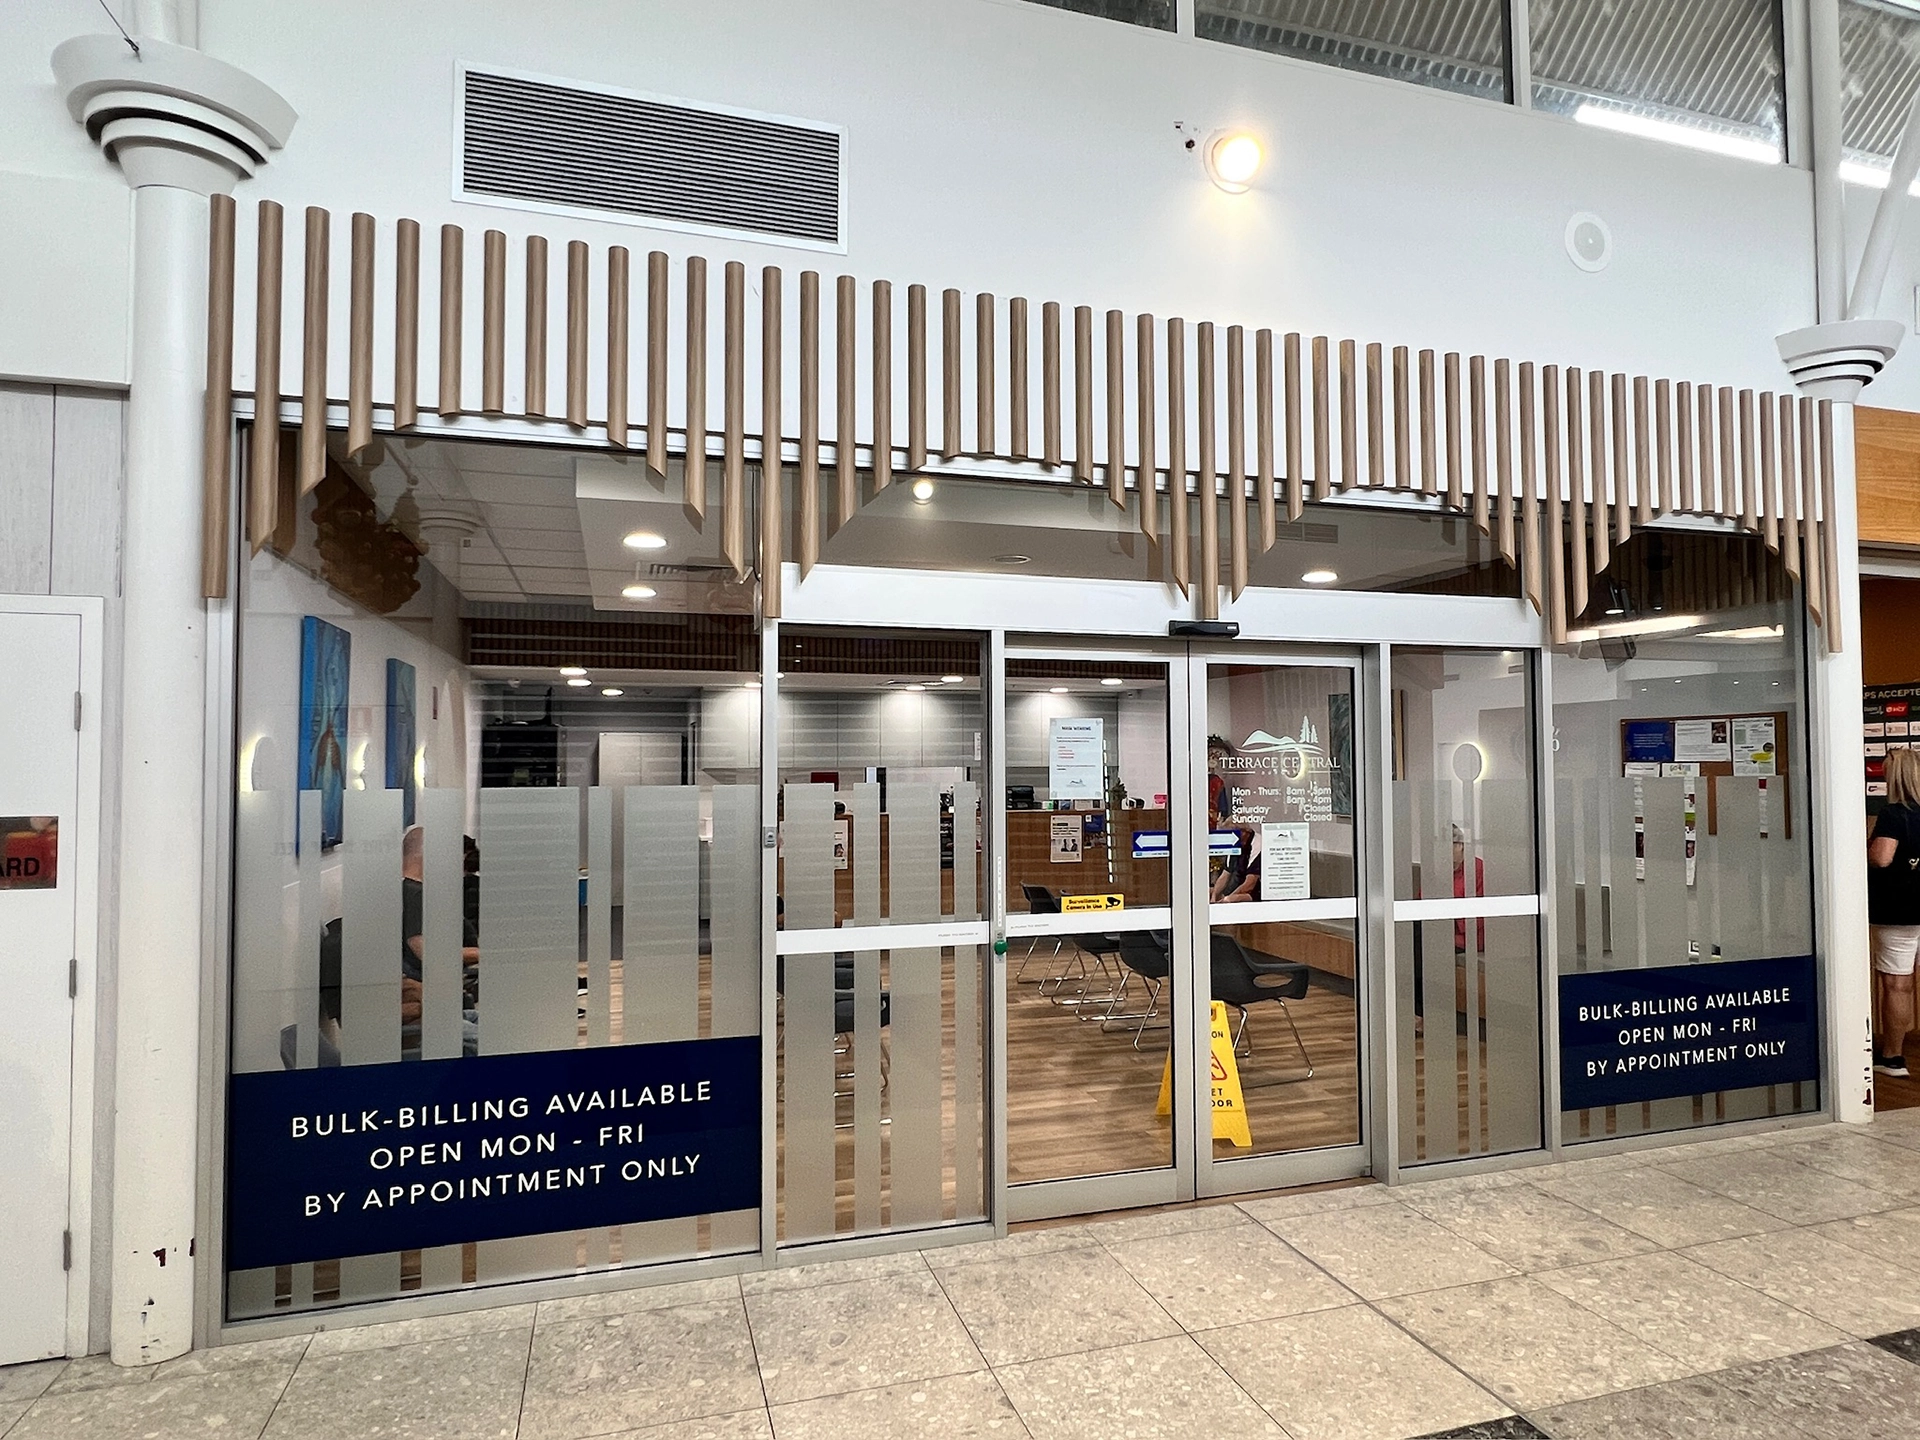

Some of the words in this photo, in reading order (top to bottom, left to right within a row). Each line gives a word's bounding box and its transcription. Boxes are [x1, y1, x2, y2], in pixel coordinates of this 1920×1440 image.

[1863, 691, 1877, 699] PS
[1219, 757, 1279, 768] TERRACE
[1282, 756, 1341, 768] CETRAL
[1232, 787, 1251, 796] Mon
[1286, 786, 1305, 795] 8am
[1286, 796, 1306, 804] 8am
[1313, 796, 1332, 805] 4pm
[1303, 804, 1332, 812] Closed
[1303, 813, 1332, 822] Closed
[0, 857, 40, 877] RD
[1579, 996, 1698, 1021] BULK-BILLING
[1705, 988, 1790, 1009] AVAILABLE
[1618, 1027, 1665, 1045] OPEN
[1673, 1022, 1712, 1040] MON
[1732, 1017, 1756, 1034] FRI
[1586, 1060, 1608, 1077] BY
[1615, 1045, 1738, 1073] APPOINTMENT
[1745, 1040, 1786, 1058] ONLY
[291, 1097, 530, 1138] BULK-BILLING
[545, 1080, 712, 1116] AVAILABLE
[370, 1141, 462, 1170] OPEN
[480, 1132, 556, 1159] MON
[599, 1123, 644, 1147] FRI
[305, 1192, 346, 1217] BY
[362, 1163, 606, 1210] APPOINTMENT
[621, 1153, 700, 1181] ONLY
